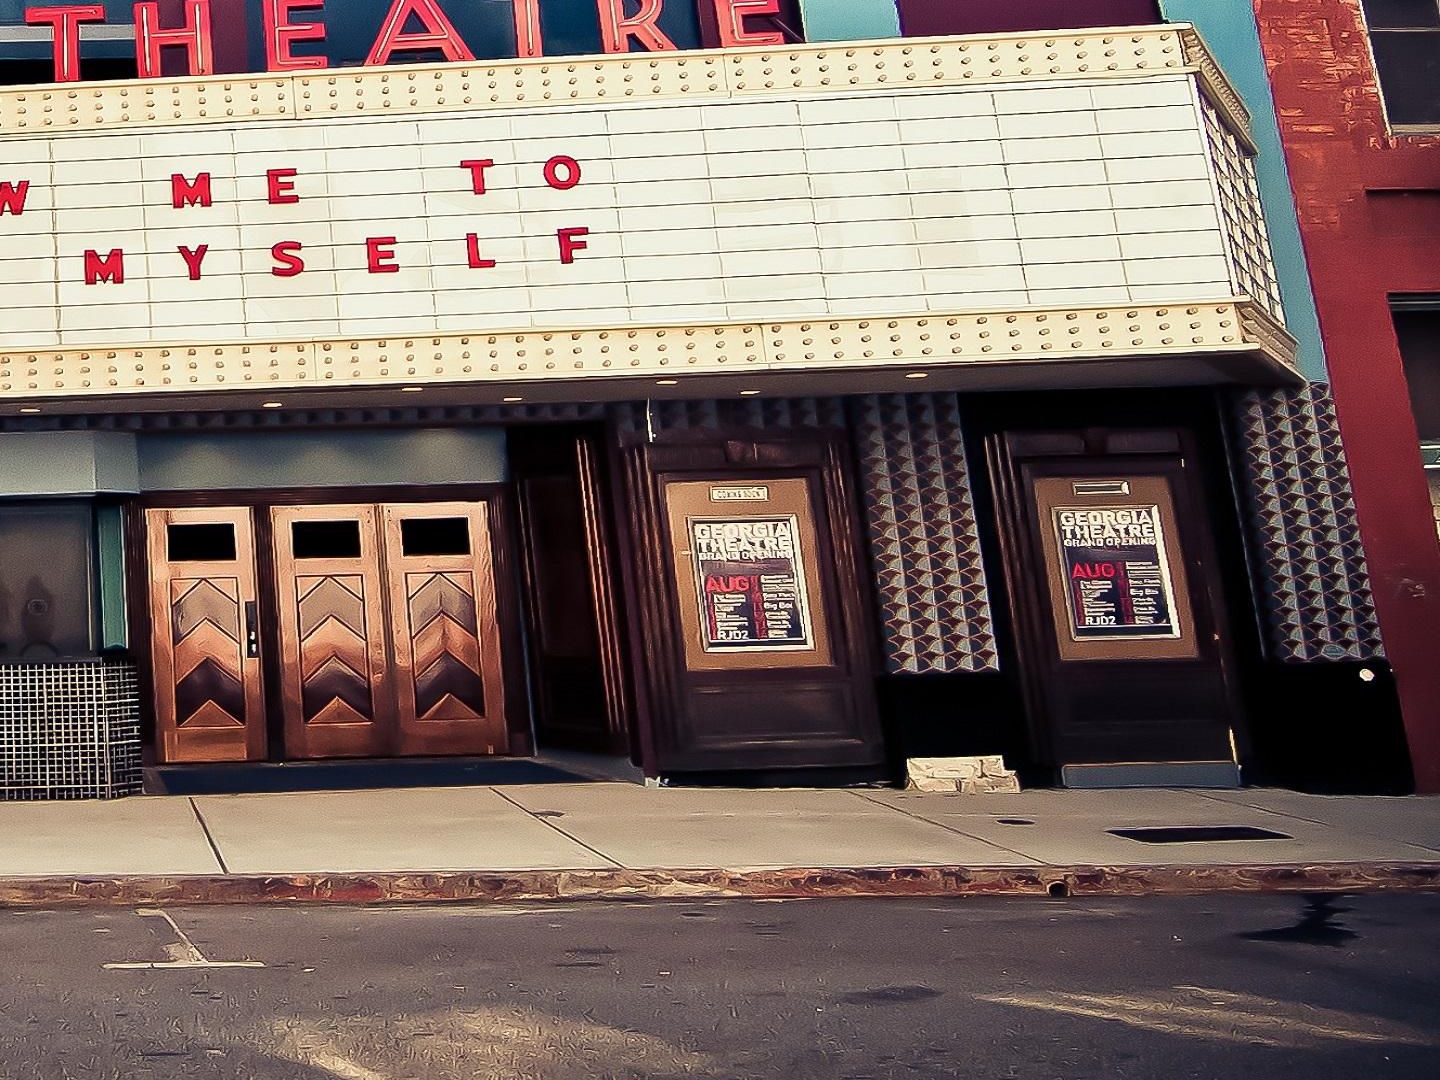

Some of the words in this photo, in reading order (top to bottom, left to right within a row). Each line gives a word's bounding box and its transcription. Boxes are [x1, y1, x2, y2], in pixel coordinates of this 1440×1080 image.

[171, 168, 300, 209] ME
[460, 155, 581, 195] TO
[83, 226, 589, 285] MYSELF
[1060, 510, 1153, 526] GEORGIA
[694, 522, 789, 539] GEORGIA
[1061, 524, 1154, 539] THEATRE
[697, 537, 791, 553] THEATRE
[1063, 538, 1103, 547] GRAND
[1105, 537, 1156, 547] OPENING
[1071, 562, 1116, 579] AUG
[706, 574, 750, 592] AUG
[1085, 616, 1117, 625] RJD2
[717, 630, 749, 640] RJD2
